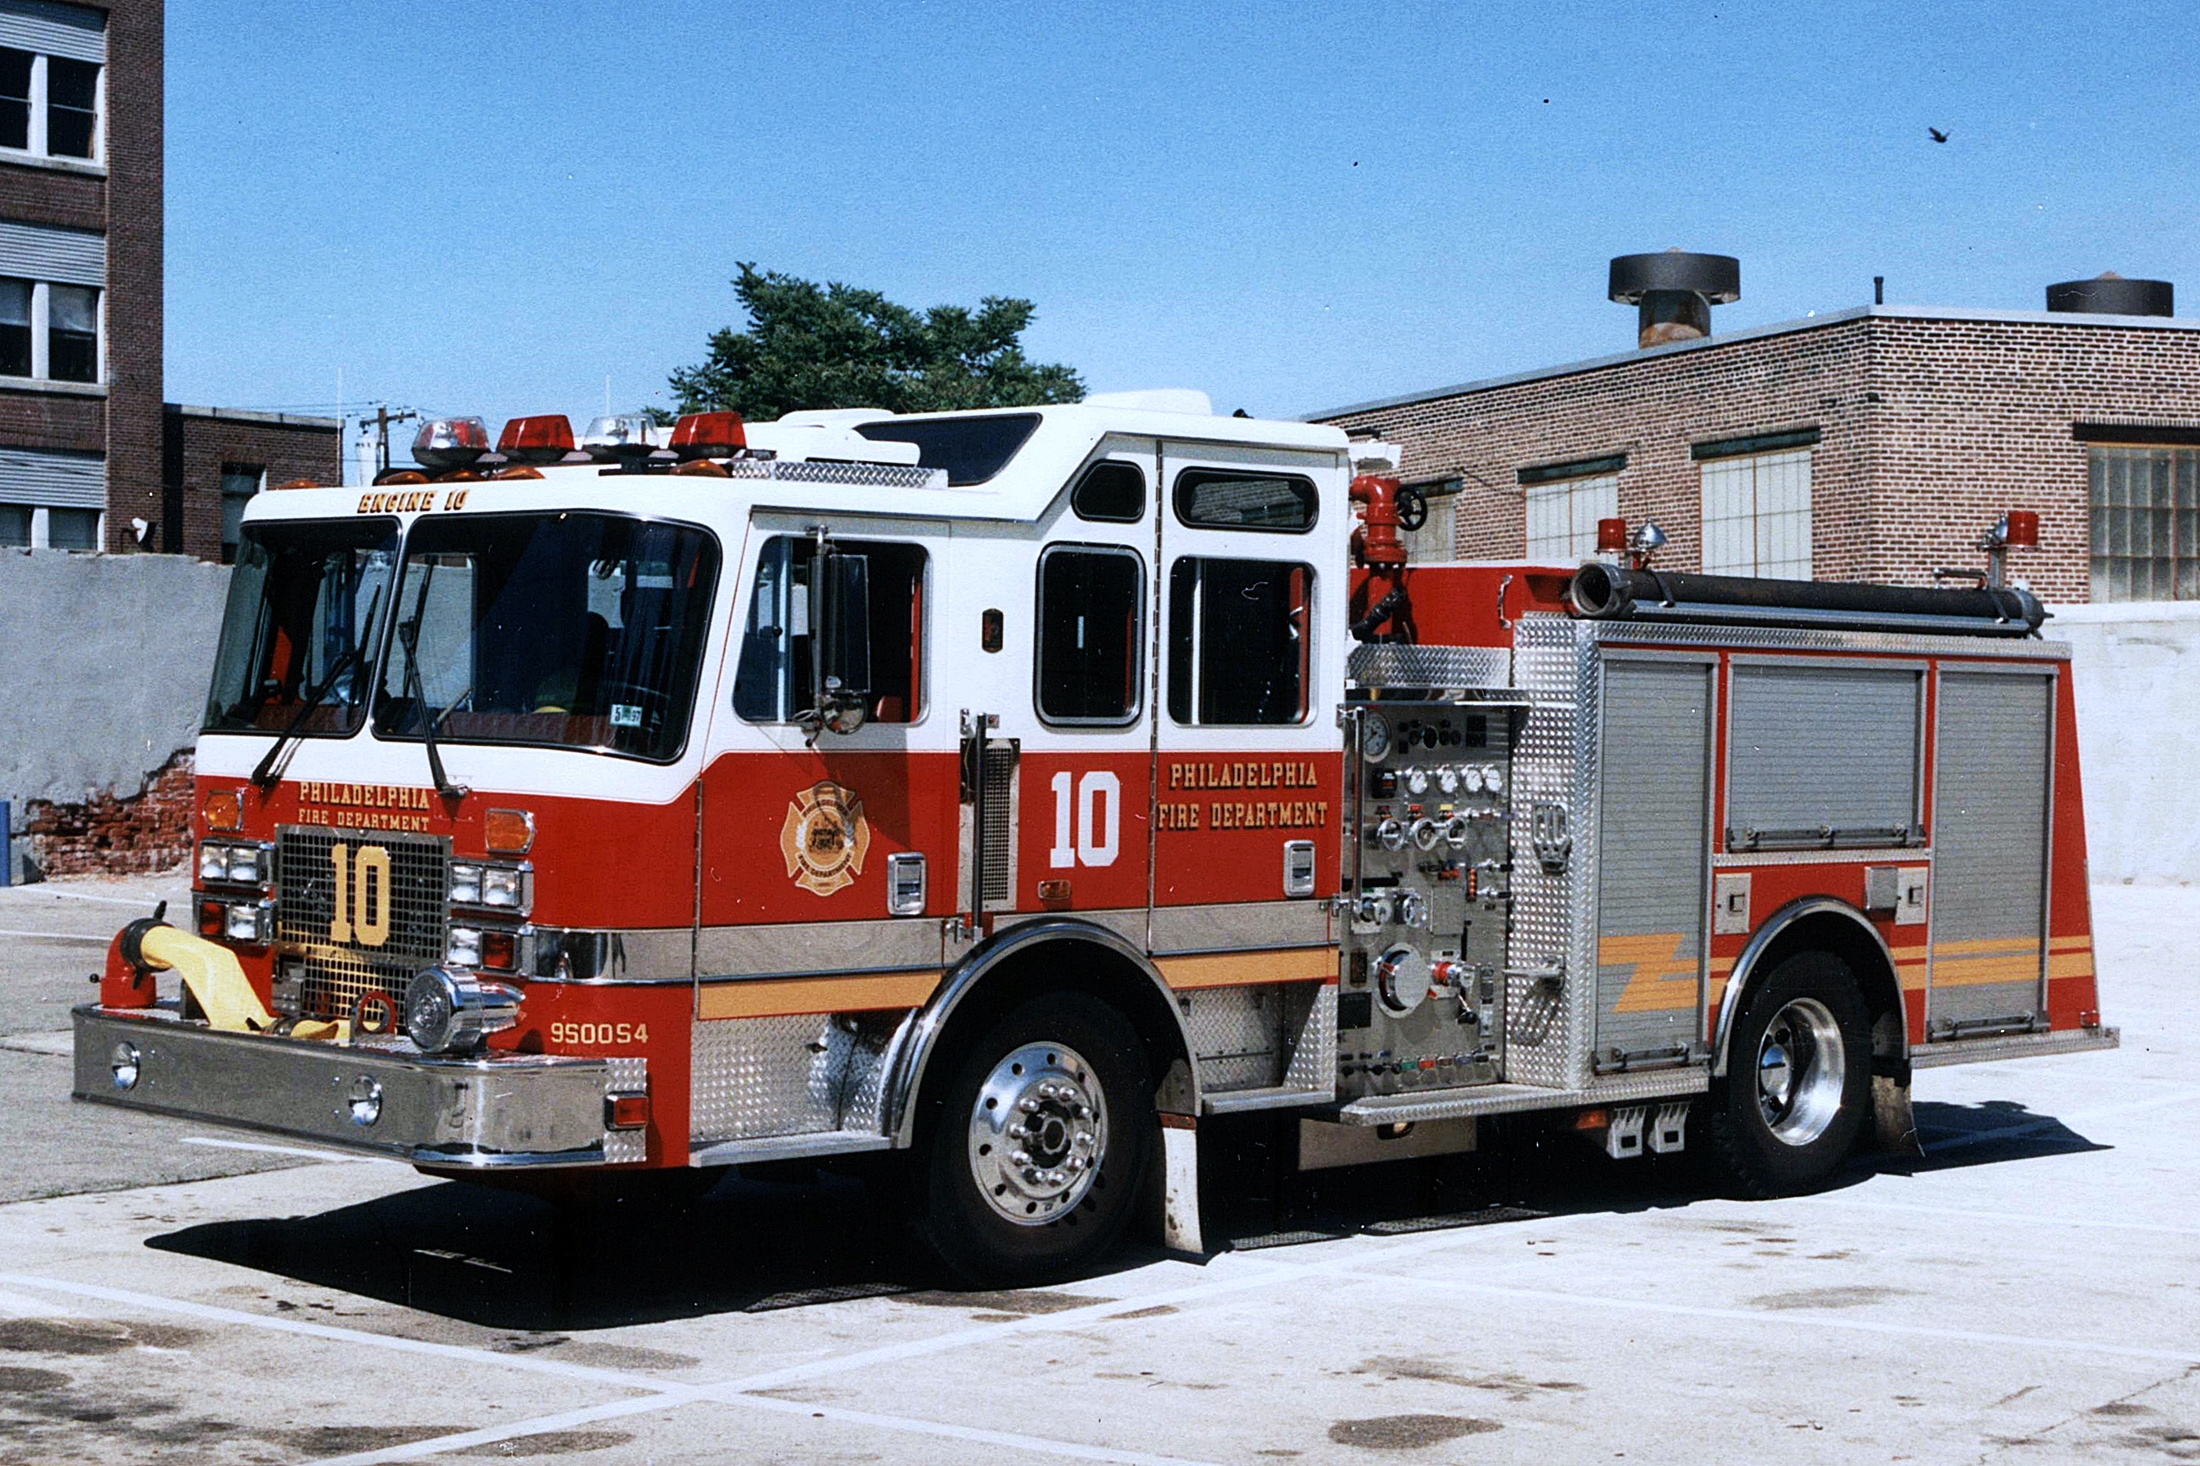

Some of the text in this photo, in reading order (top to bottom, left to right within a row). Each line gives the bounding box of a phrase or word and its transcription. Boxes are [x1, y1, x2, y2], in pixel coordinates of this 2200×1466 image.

[357, 489, 469, 513] ENGINE 10
[1169, 763, 1317, 790] PHILADELPHIA
[300, 782, 430, 810] PHILADELPHIA
[299, 808, 430, 832] FIRE DEPARTMENT
[1050, 771, 1120, 868] 10
[1156, 802, 1328, 830] FIRE DEPARTMENT
[331, 843, 390, 946] 10
